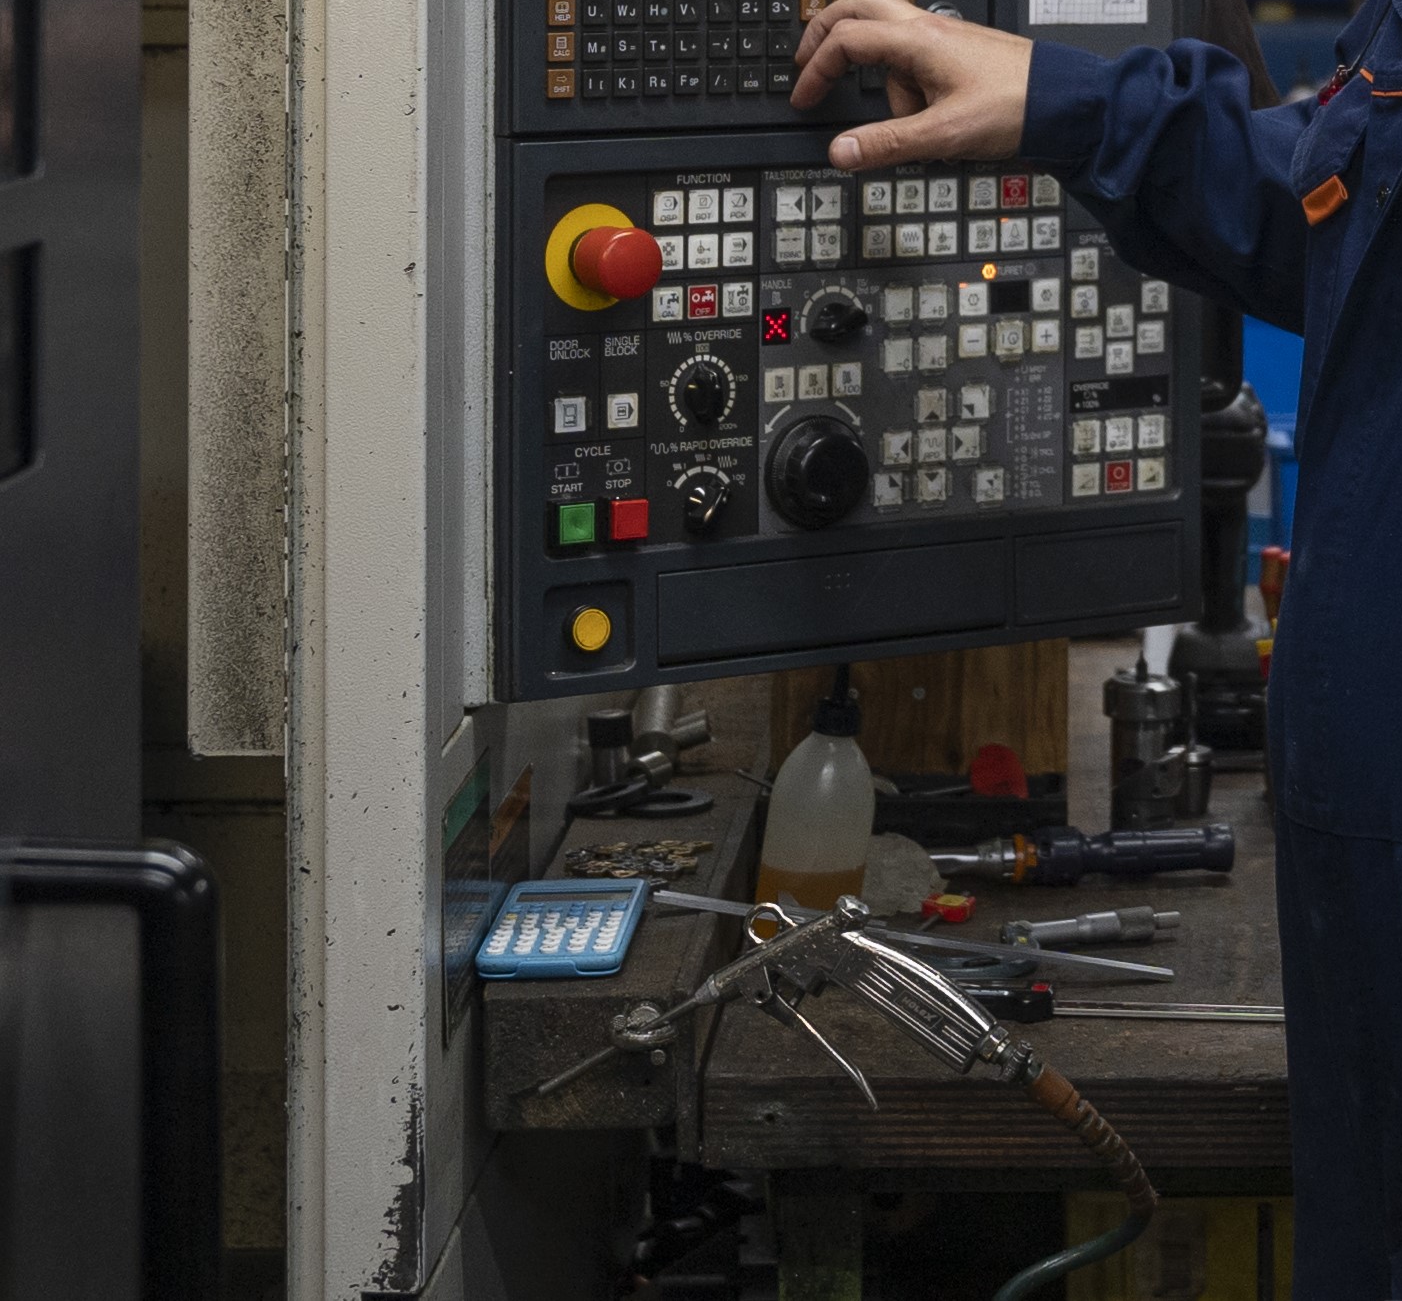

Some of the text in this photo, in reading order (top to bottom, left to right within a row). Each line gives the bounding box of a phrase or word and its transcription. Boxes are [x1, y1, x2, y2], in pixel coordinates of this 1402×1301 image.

[772, 1, 780, 13] 3
[555, 14, 571, 22] HELP
[773, 74, 789, 82] CAN
[743, 80, 759, 88] EOB
[676, 173, 731, 185] FUNCTION
[761, 278, 792, 291] HANDLE
[695, 308, 711, 316] OFF
[604, 335, 641, 347] SINGLE
[694, 329, 743, 342] OVERRIDE
[550, 340, 579, 351] DOOR
[550, 349, 591, 360] UNLOCK
[604, 346, 638, 357] BLOCK
[735, 374, 748, 382] 150
[660, 380, 669, 388] 50
[679, 440, 708, 452] RAPID
[709, 436, 753, 450] OVERRIDE
[574, 445, 612, 458] CYCLE
[551, 482, 584, 495] START
[605, 478, 632, 490] STOP
